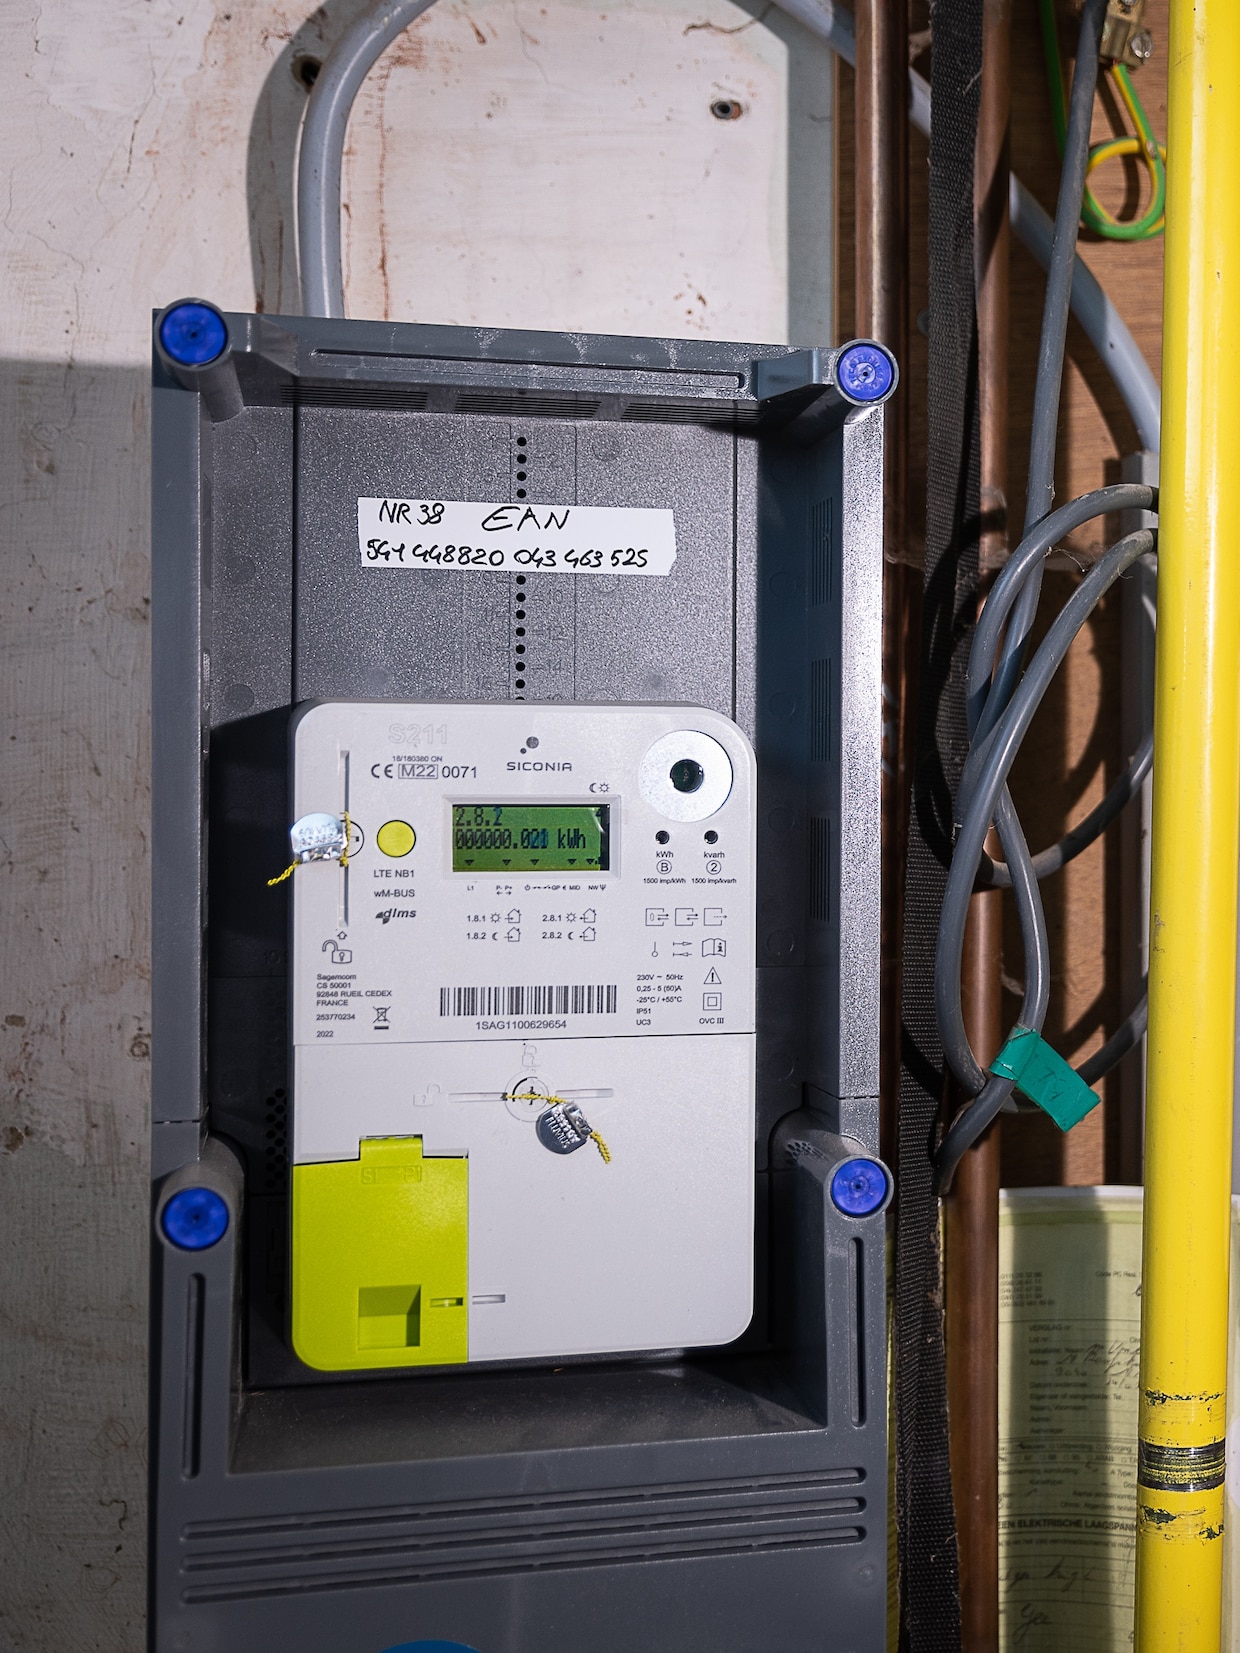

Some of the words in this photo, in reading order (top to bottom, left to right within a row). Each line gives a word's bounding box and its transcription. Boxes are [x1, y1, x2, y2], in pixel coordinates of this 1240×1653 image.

[378, 500, 412, 525] NR
[417, 503, 445, 526] 38
[481, 504, 571, 532] EAN
[564, 549, 604, 568] 463
[611, 548, 649, 568] 525
[388, 723, 448, 745] S211
[401, 764, 436, 778] M22
[441, 766, 478, 779] 0071
[506, 761, 572, 772] SICONIA
[557, 828, 586, 849] kWh
[703, 851, 725, 859] kvarh
[373, 869, 392, 878] LTE
[394, 869, 415, 878] NB1
[659, 877, 686, 885] imp/kWh
[707, 877, 737, 885] imp/kvarh
[373, 888, 416, 898] wM-BUS
[382, 908, 417, 918] dlms
[316, 973, 357, 981] Sagemcom
[475, 1020, 567, 1030] 1SAG1100629654
[698, 1017, 715, 1025] OVC
[316, 1030, 334, 1038] 2022
